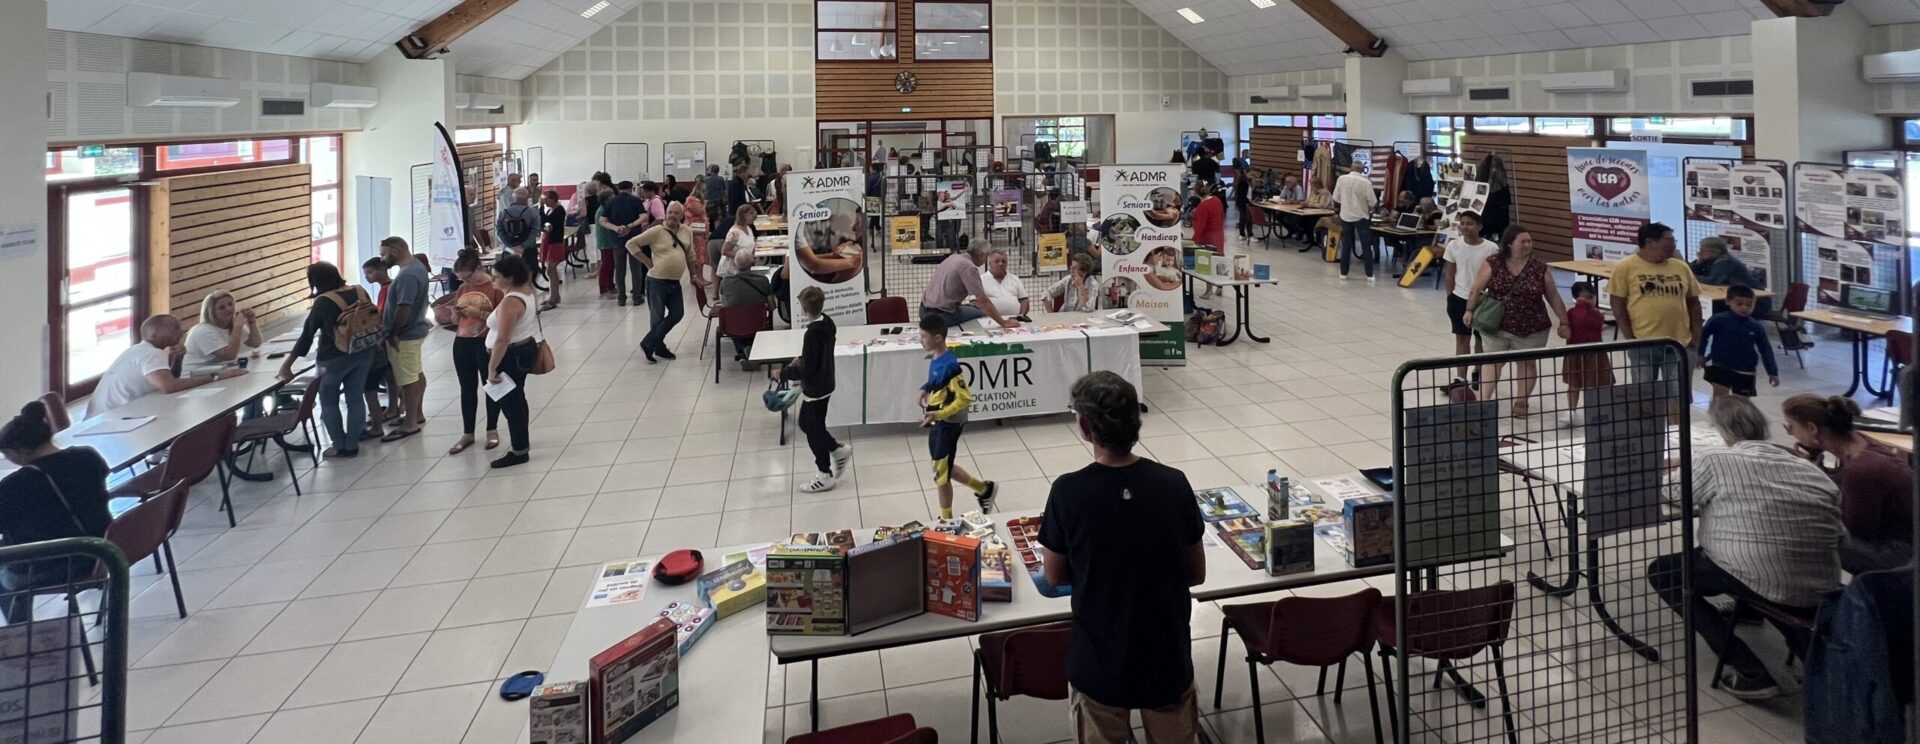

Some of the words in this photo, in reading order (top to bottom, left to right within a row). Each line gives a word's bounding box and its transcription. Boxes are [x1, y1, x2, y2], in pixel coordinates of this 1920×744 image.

[1596, 154, 1606, 164] de
[1608, 156, 1640, 174] secours
[816, 176, 850, 188] ADMR
[1130, 172, 1166, 182] ADMR
[1577, 188, 1594, 203] vers
[1613, 190, 1641, 208] autres
[1122, 200, 1151, 208] Seniors
[798, 210, 828, 220] Seniors
[1142, 233, 1178, 242] Handicap
[1119, 264, 1148, 273] Enfance
[1136, 299, 1169, 308] Maison
[992, 399, 1036, 410] DOMICILE
